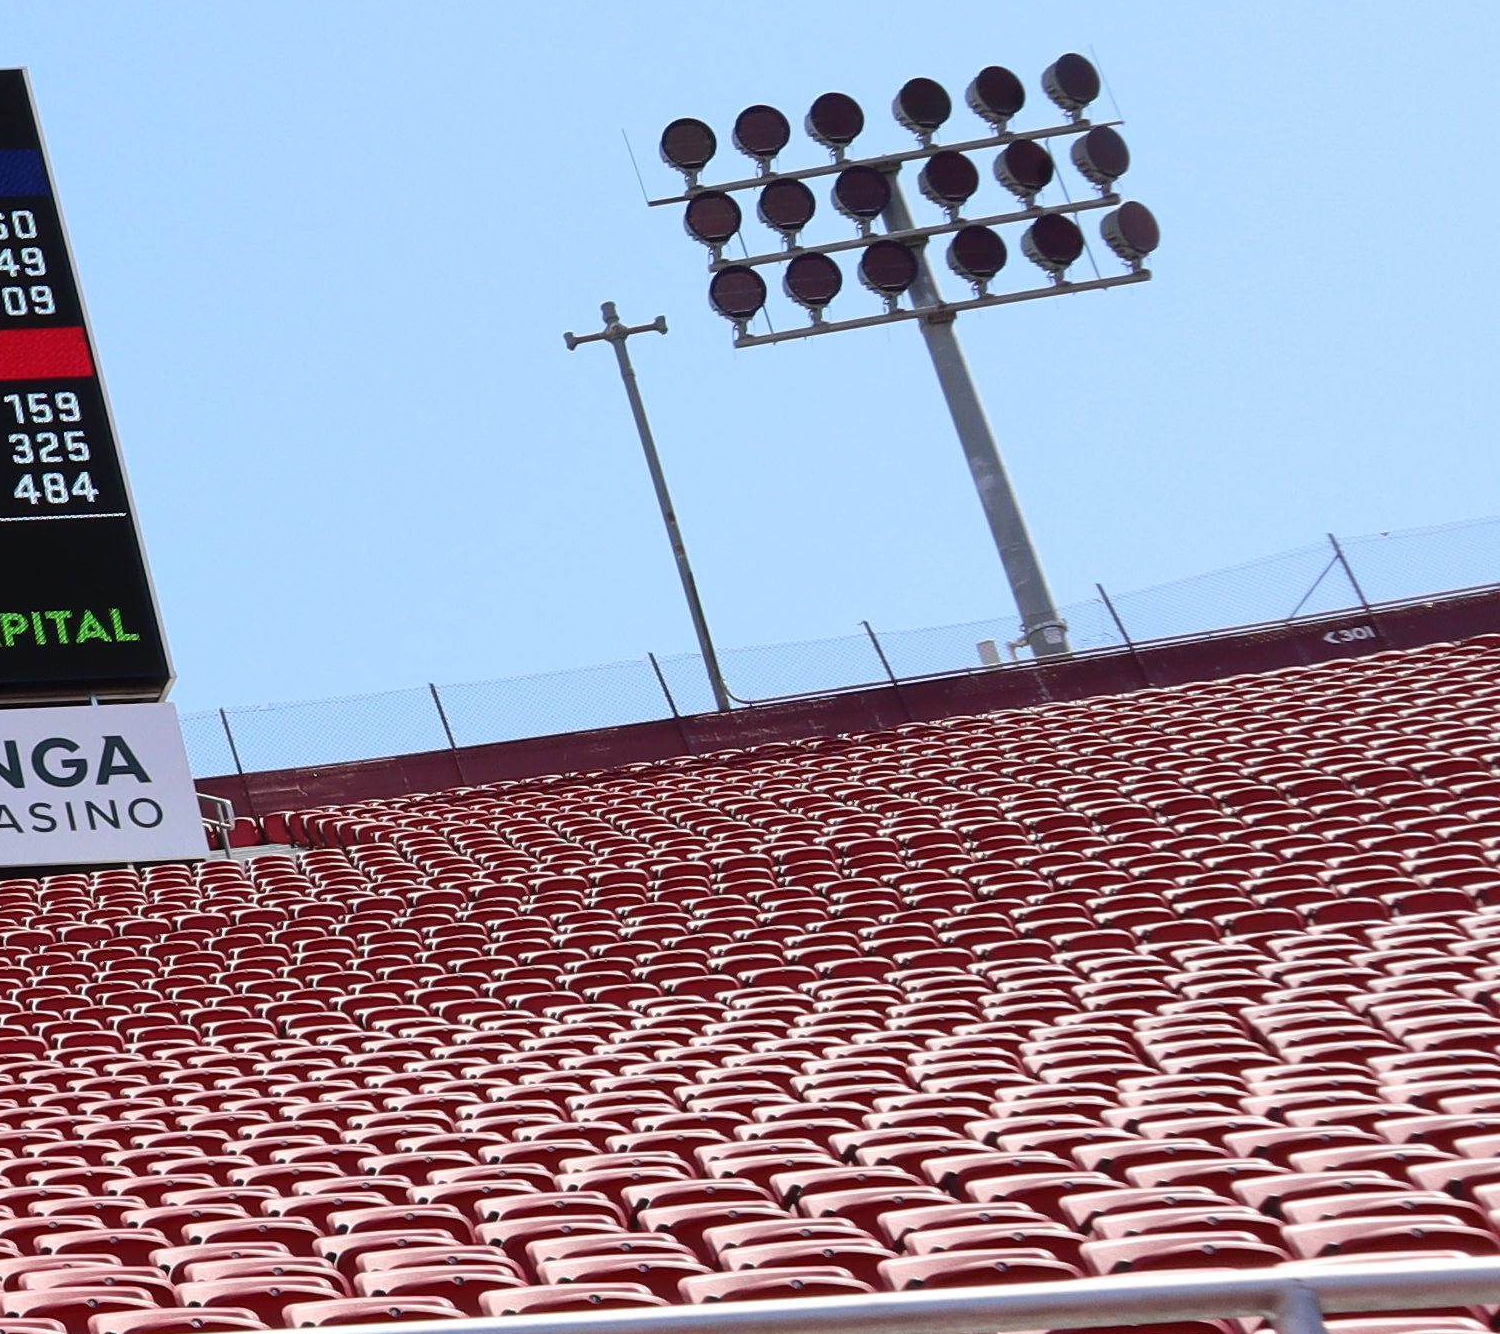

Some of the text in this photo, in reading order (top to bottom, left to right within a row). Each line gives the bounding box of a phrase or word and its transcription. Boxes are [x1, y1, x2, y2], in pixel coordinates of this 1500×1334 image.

[3, 391, 82, 424] 159
[8, 430, 91, 465] 325
[11, 471, 100, 505] 484
[1338, 626, 1376, 643] 301
